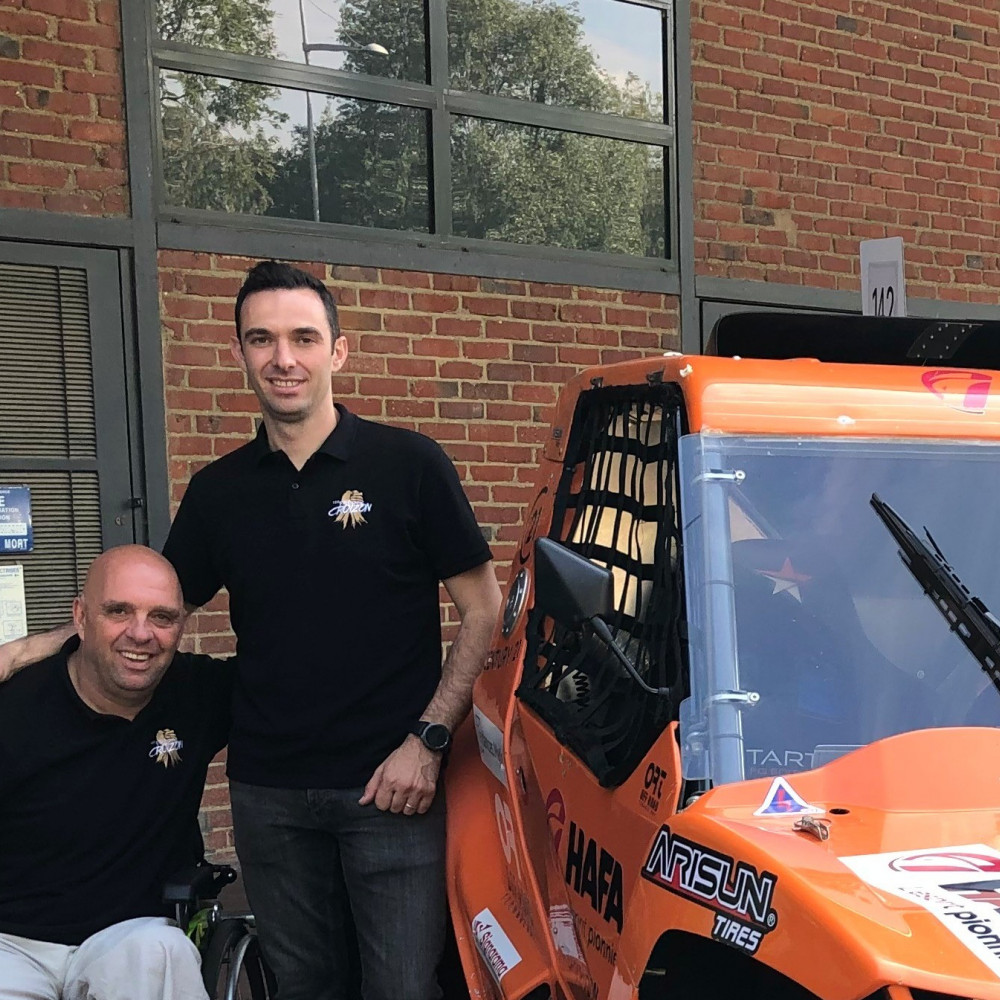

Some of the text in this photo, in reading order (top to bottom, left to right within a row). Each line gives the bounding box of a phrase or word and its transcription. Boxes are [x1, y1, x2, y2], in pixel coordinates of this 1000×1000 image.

[4, 538, 28, 549] MORT
[566, 820, 623, 935] HAFA
[647, 829, 774, 923] ARISUN
[588, 925, 618, 967] pionnie
[714, 914, 763, 951] TIRES
